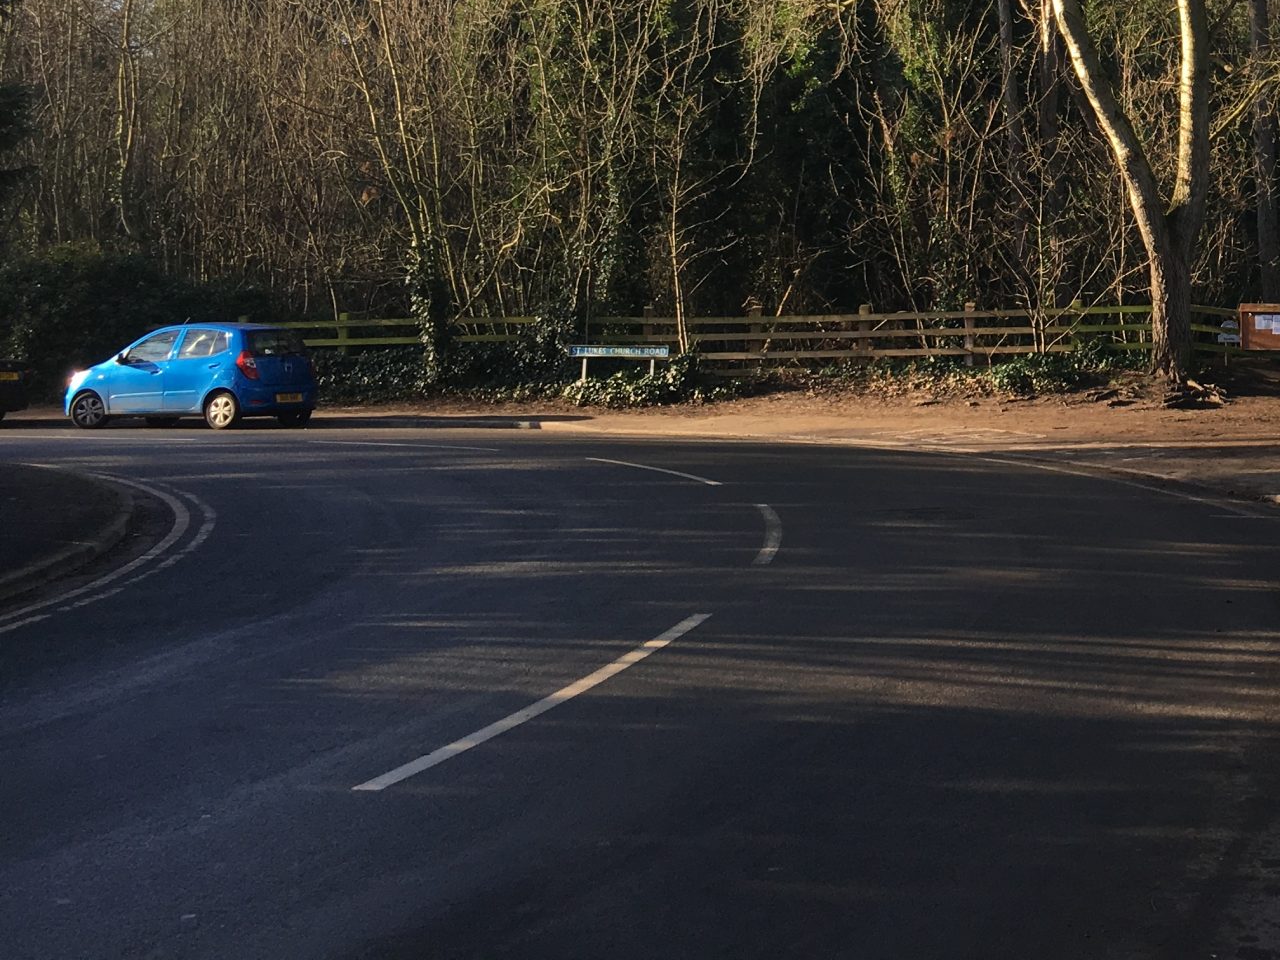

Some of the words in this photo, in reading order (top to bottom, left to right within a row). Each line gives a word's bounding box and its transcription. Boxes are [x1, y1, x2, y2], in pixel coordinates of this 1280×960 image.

[572, 347, 582, 355] ST
[585, 347, 606, 355] LUKES
[610, 347, 641, 355] CHURCH
[644, 347, 666, 356] ROAD
